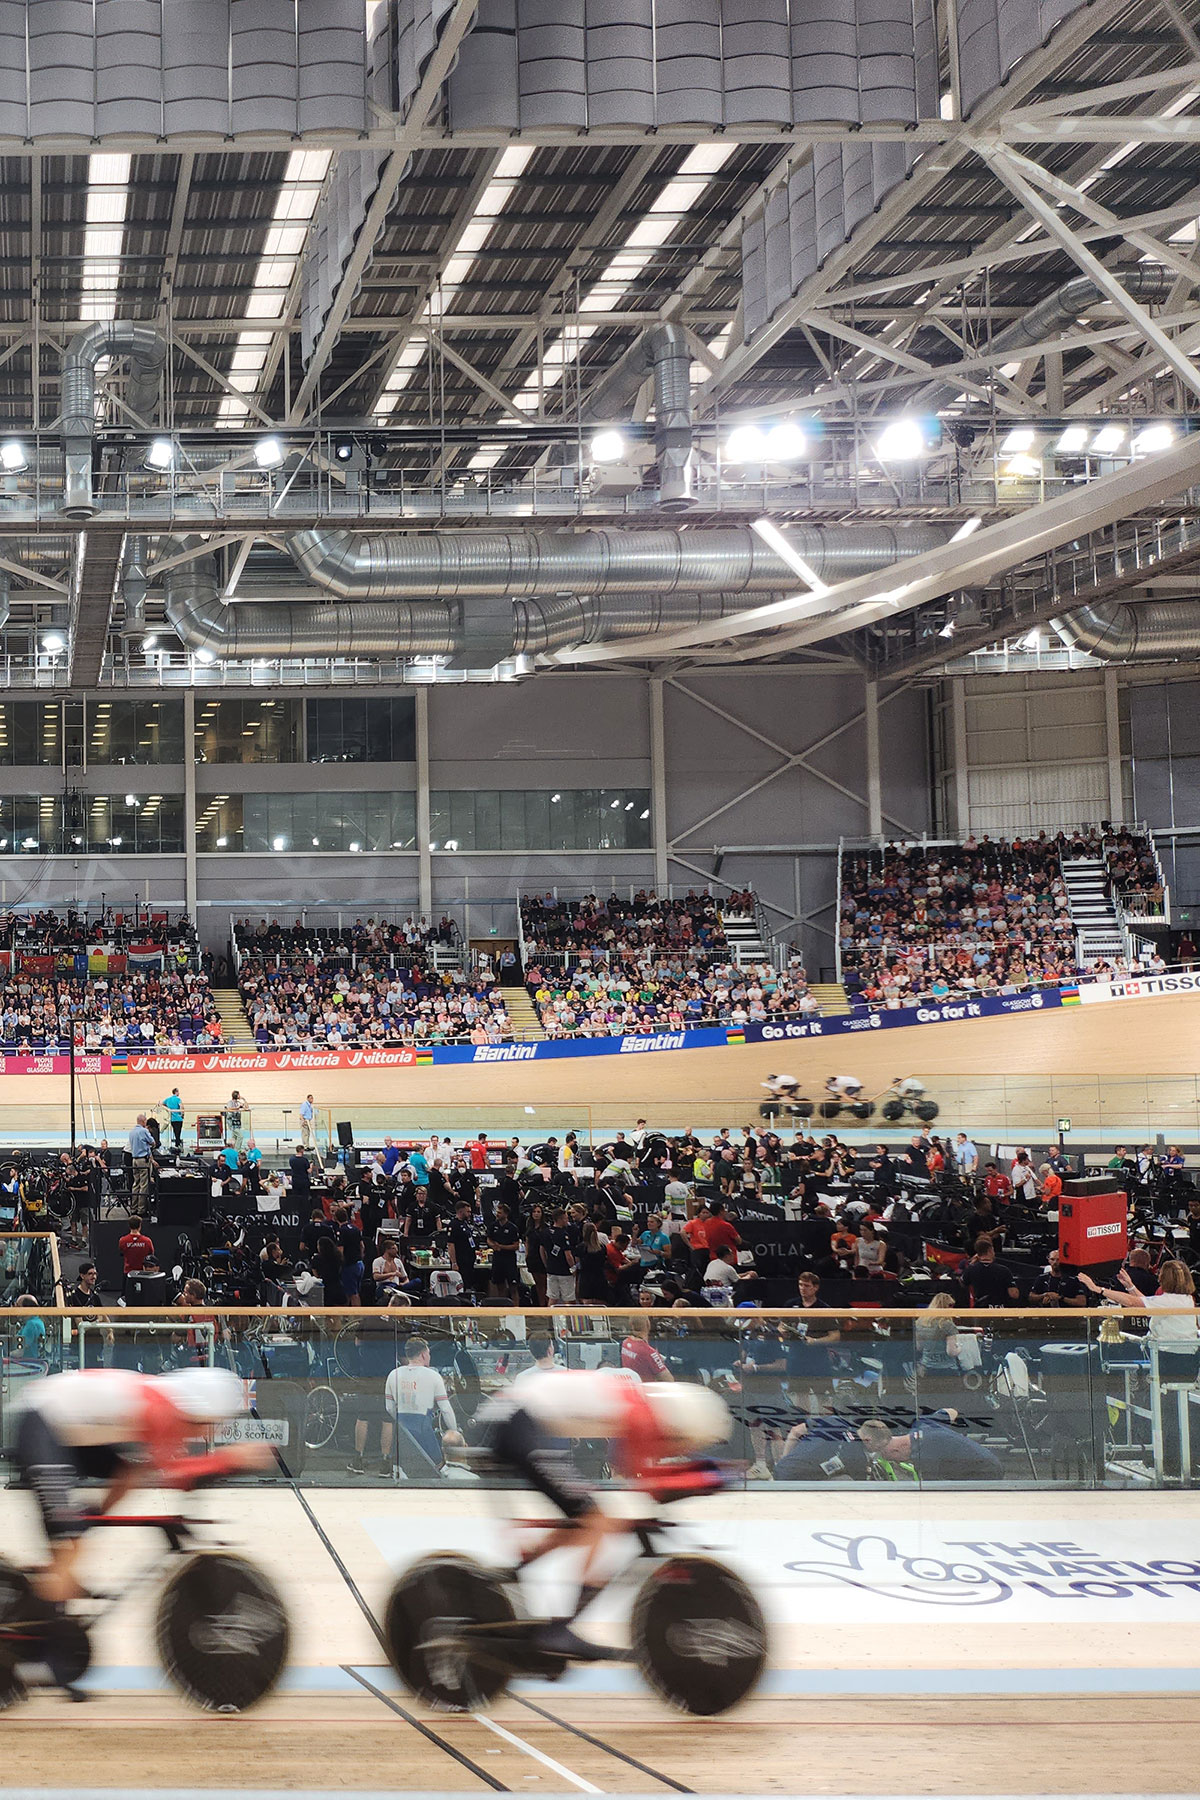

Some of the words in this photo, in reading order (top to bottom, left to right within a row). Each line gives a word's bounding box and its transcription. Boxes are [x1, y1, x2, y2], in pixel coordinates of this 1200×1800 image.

[916, 1008, 940, 1022] Go
[941, 1005, 965, 1020] for
[966, 1003, 981, 1016] it
[761, 1025, 784, 1039] Go
[785, 1023, 808, 1037] for
[809, 1021, 822, 1035] it
[620, 1031, 686, 1053] Santini
[292, 1052, 340, 1067] vittoria
[365, 1050, 412, 1065] vittoria
[473, 1042, 538, 1062] Santini
[146, 1056, 196, 1071] vittoria
[218, 1055, 267, 1069] vittoria
[226, 1214, 300, 1226] SCOTLAND
[1097, 1224, 1120, 1235] TISSOT
[942, 1541, 1100, 1557] THE
[984, 1560, 1200, 1577] NATIO
